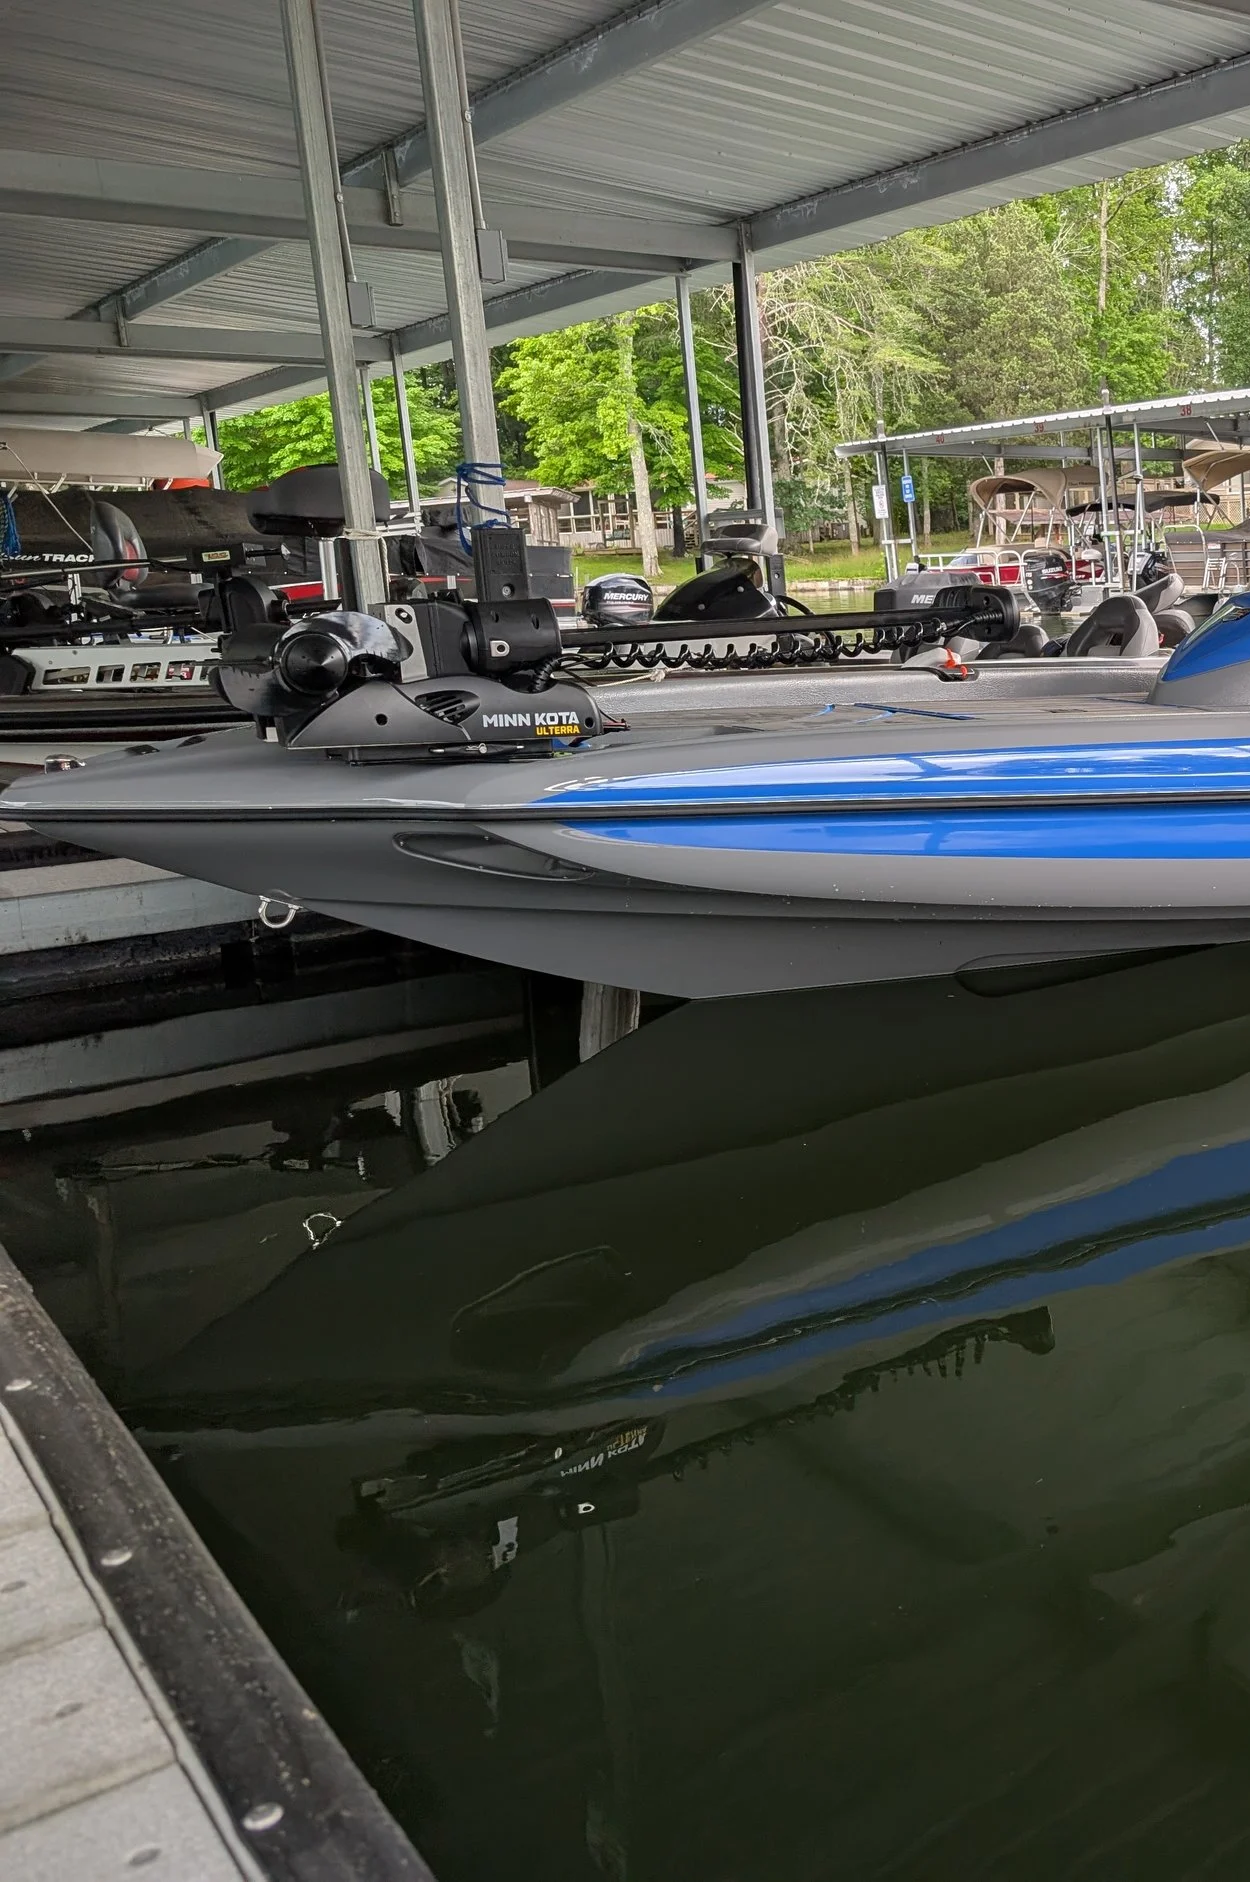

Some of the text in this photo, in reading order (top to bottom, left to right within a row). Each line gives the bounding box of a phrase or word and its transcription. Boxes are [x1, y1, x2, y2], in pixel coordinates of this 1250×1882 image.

[1180, 404, 1192, 417] 38
[1034, 422, 1045, 433] 39
[935, 434, 945, 445] 40
[603, 592, 649, 601] MERCURY
[482, 711, 580, 728] MINN KOTA
[536, 725, 580, 736] ULTERRA
